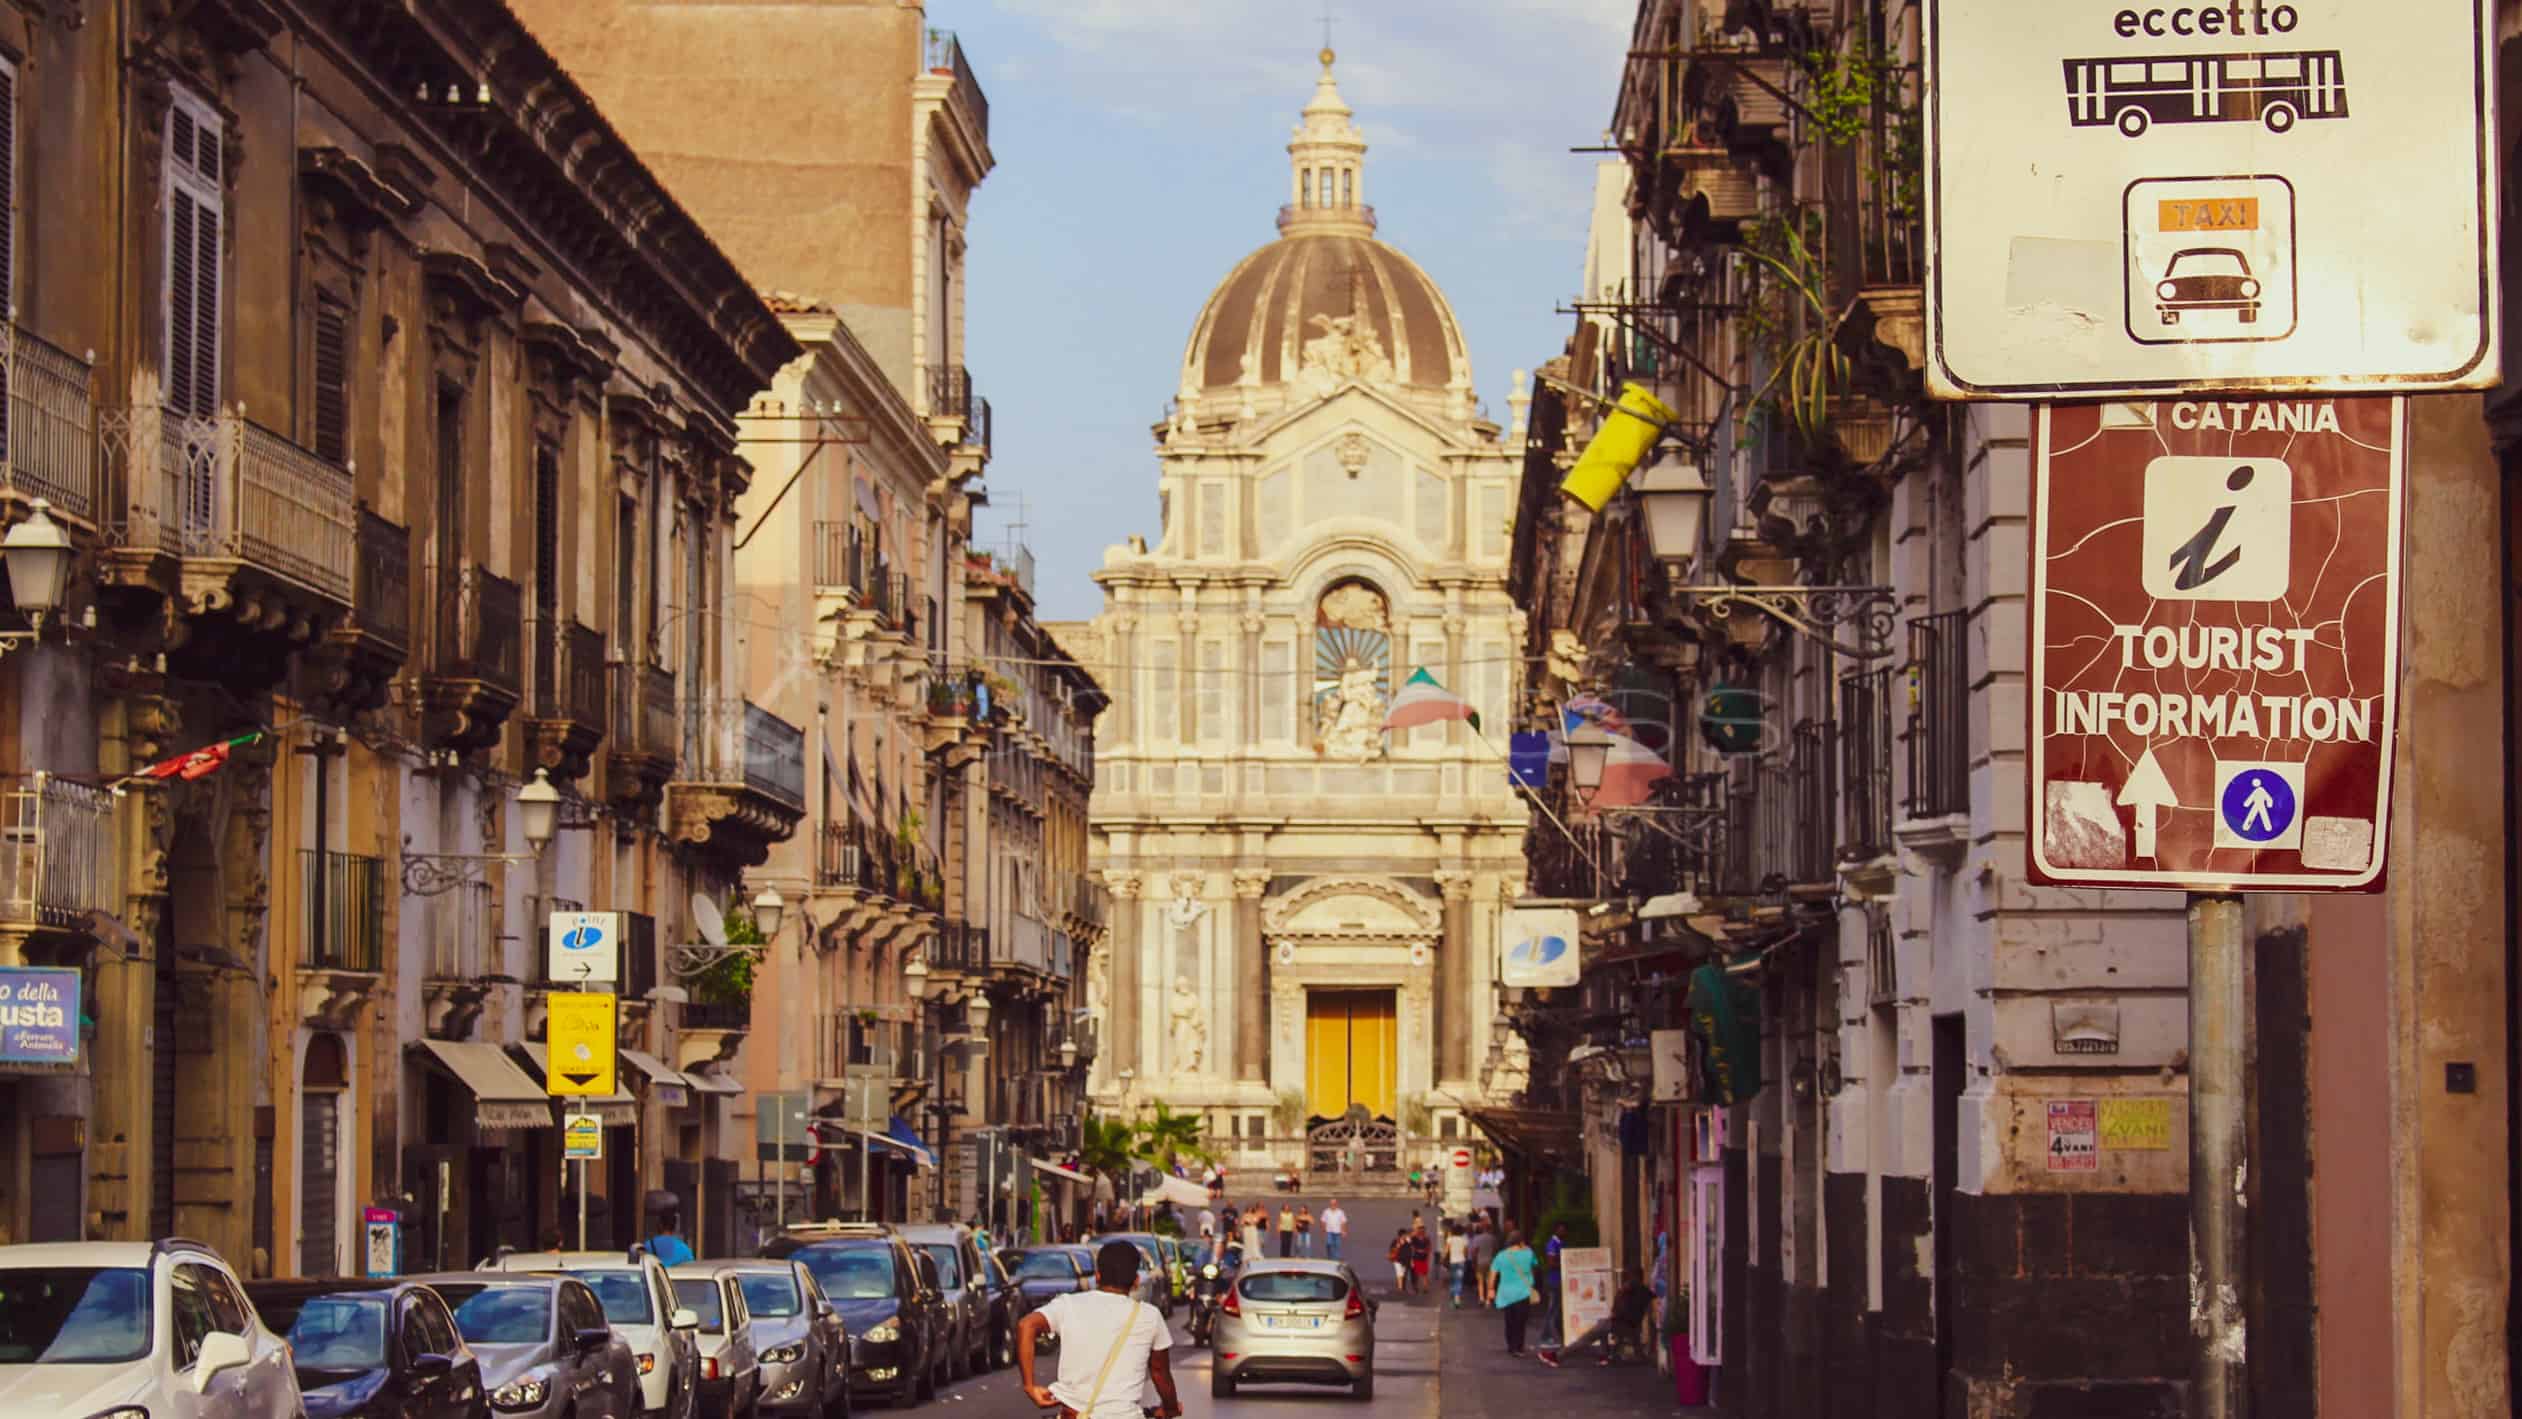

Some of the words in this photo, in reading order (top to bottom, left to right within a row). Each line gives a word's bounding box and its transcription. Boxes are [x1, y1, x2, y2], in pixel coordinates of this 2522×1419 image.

[2114, 0, 2299, 38] eccetto
[2173, 202, 2247, 227] TAXI
[2171, 401, 2340, 433] CATANIA
[2113, 624, 2315, 671] TOURIST
[2056, 691, 2371, 742] INFORMATION
[17, 982, 57, 1001] della
[2051, 1136, 2063, 1155] 4
